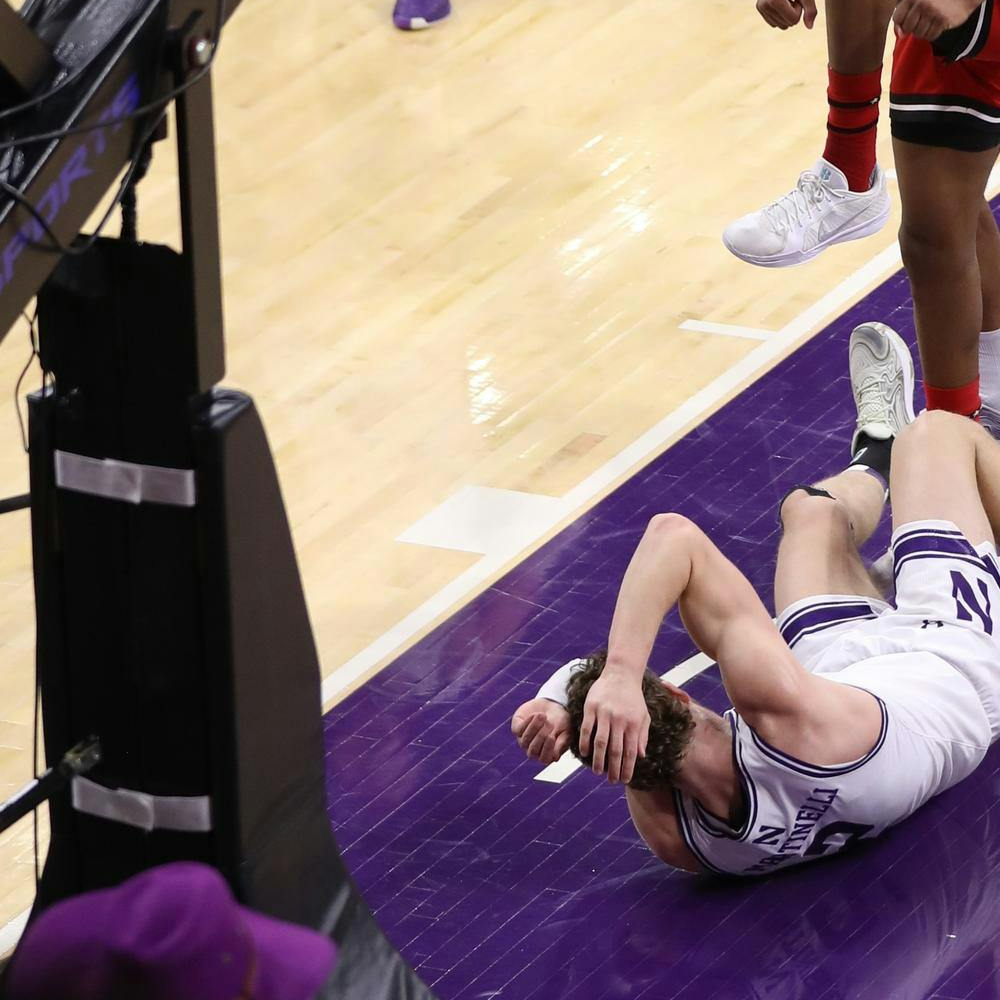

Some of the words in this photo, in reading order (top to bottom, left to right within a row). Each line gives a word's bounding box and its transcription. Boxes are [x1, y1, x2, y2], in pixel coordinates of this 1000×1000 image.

[0, 72, 141, 295] PORTS
[949, 569, 994, 637] N
[752, 824, 787, 846] N
